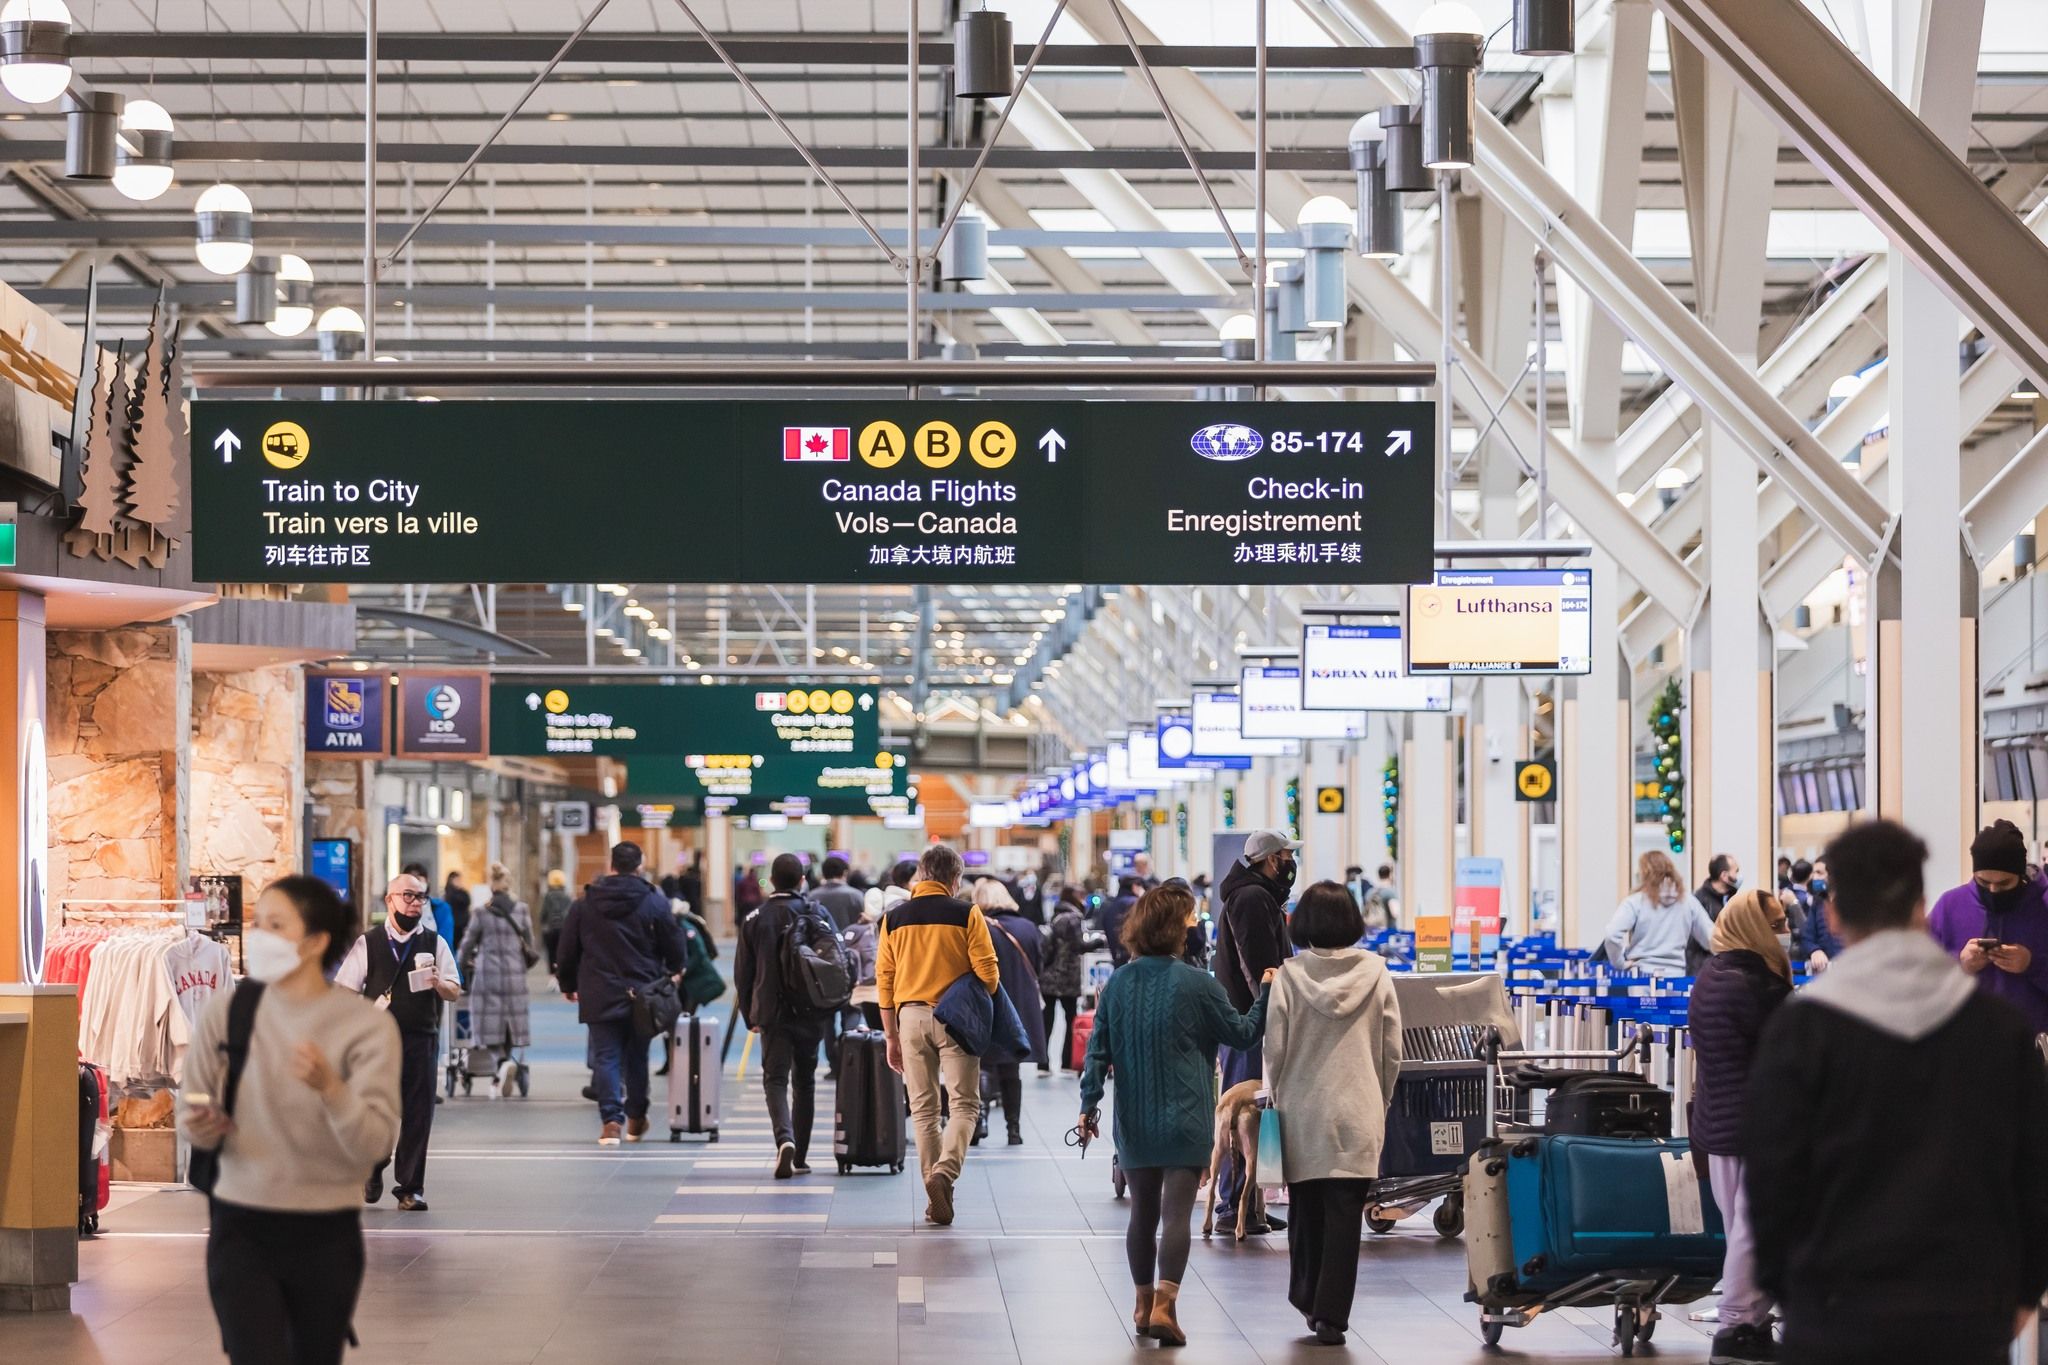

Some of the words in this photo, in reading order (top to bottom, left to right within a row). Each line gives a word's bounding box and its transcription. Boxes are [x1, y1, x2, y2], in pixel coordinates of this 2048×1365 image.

[868, 430, 894, 457] A
[927, 430, 950, 457] B
[980, 430, 1006, 458] C
[1271, 431, 1364, 454] 85-174
[262, 480, 325, 502] Train
[332, 480, 360, 502] to
[368, 479, 420, 506] City
[822, 478, 923, 502] Canada
[931, 478, 1017, 506] Flights
[1247, 476, 1364, 500] Check-in
[262, 511, 326, 535] Train
[333, 516, 389, 535] vers
[397, 511, 420, 535] la
[427, 511, 479, 535] ville
[1167, 509, 1362, 537] Enregistrement
[264, 543, 371, 567] 列车往市区
[869, 543, 1016, 566] 加拿大境内航班
[1233, 541, 1362, 564] 办理乘机手续
[1457, 598, 1553, 614] Lufthansa
[1311, 669, 1368, 680] KOREAN
[1373, 670, 1399, 680] AIR
[329, 712, 361, 726] RBC
[325, 732, 363, 747] ATM
